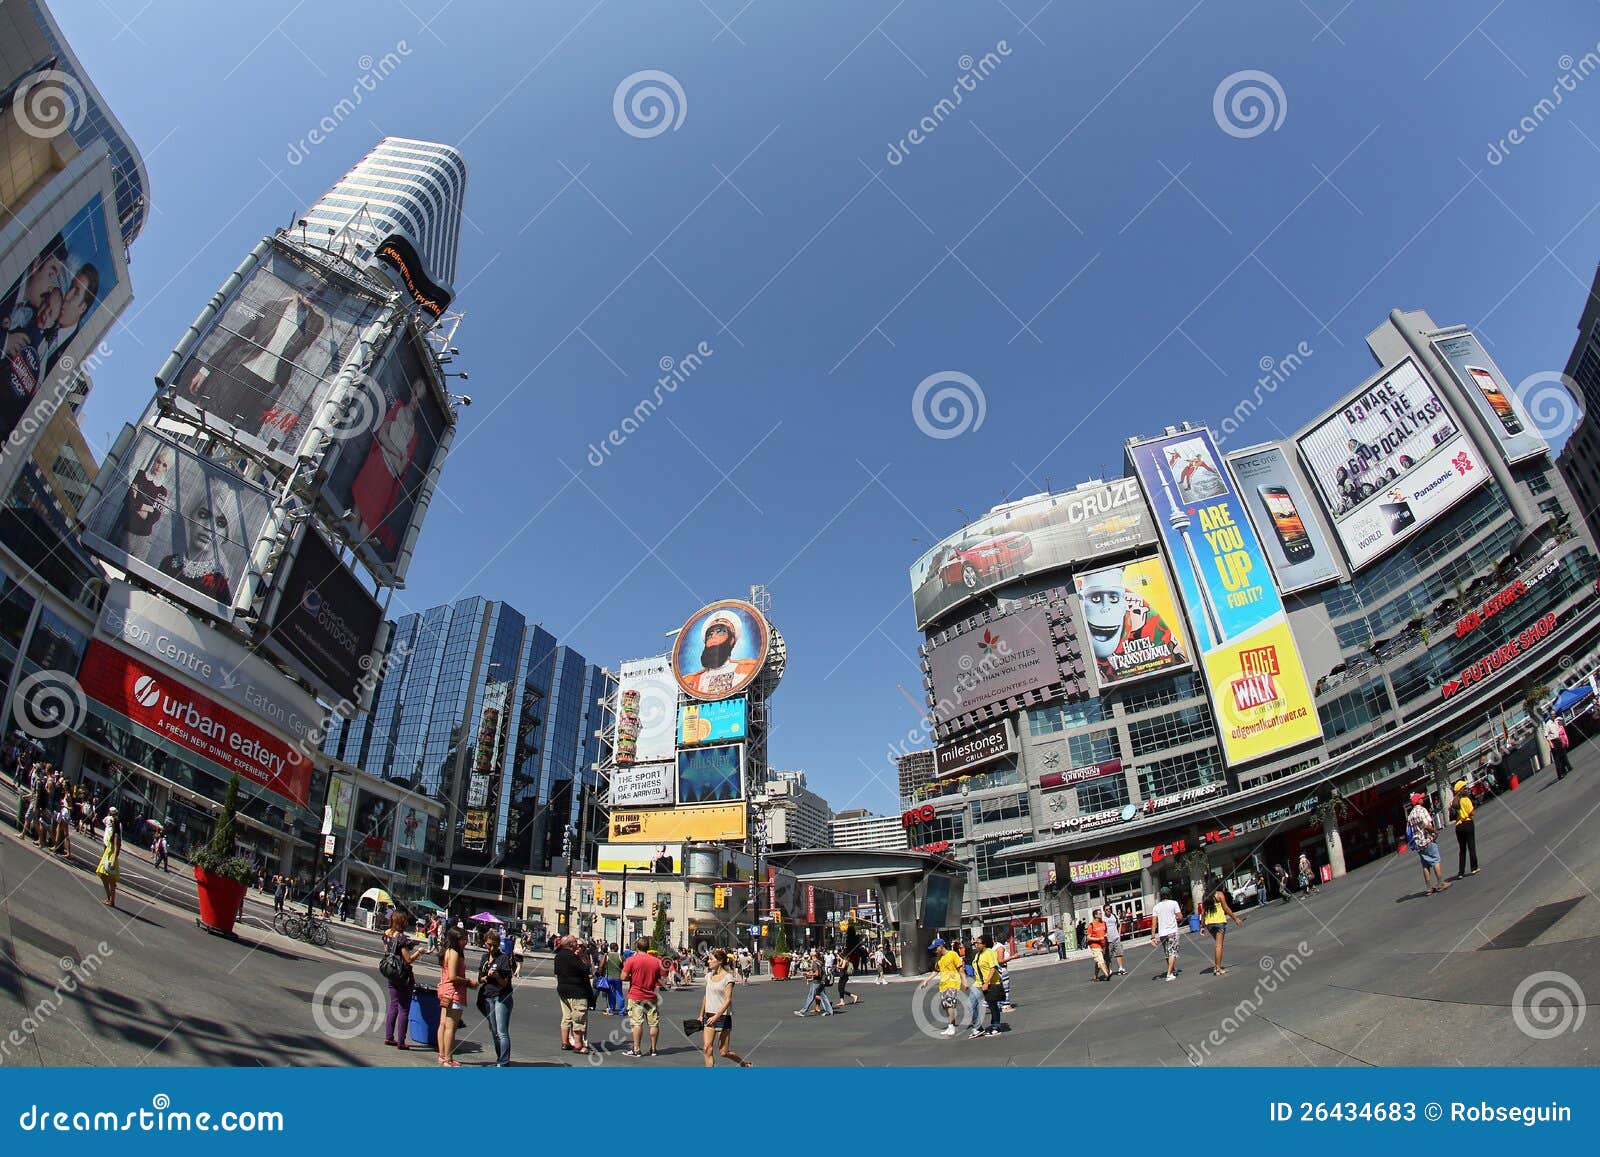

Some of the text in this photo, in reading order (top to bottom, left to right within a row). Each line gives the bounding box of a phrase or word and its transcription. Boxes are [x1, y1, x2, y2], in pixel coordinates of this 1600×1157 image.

[414, 289, 442, 315] Toronto
[1380, 394, 1411, 423] THE
[1413, 470, 1453, 500] Panasonic
[1066, 479, 1140, 524] CRUZE
[1198, 503, 1235, 532] ARE
[1095, 533, 1142, 549] CHEVROLET
[1204, 526, 1244, 554] YOU
[1214, 550, 1253, 592] UP
[1226, 586, 1263, 608] FOR IT?
[105, 609, 213, 678] Eaton Centre
[1108, 644, 1171, 670] TRANSYLVANIA
[1122, 636, 1155, 654] HOTEL
[1461, 612, 1557, 688] FUTURE SHOP
[992, 648, 1036, 669] COUNTIES
[1002, 666, 1017, 677] YOU
[1018, 658, 1041, 670] THINK
[1242, 648, 1278, 678] EDGE
[244, 685, 285, 722] Eaton
[1234, 675, 1275, 708] WALK
[163, 695, 286, 777] urban eatery
[1231, 706, 1308, 739] edgewalkcntower.ca
[157, 719, 271, 782] A FRESH NEW DINING EXPERIENCE
[941, 732, 1003, 763] milestones
[965, 751, 983, 764] GRILL
[617, 779, 662, 793] OF FITNESS
[618, 770, 661, 785] THE SPORT
[617, 787, 661, 801] HAS ARRIVED
[1143, 784, 1216, 812] EXTREME FITNESS
[1053, 808, 1120, 830] SHOPPERS
[1077, 857, 1120, 875] EATERIES!
